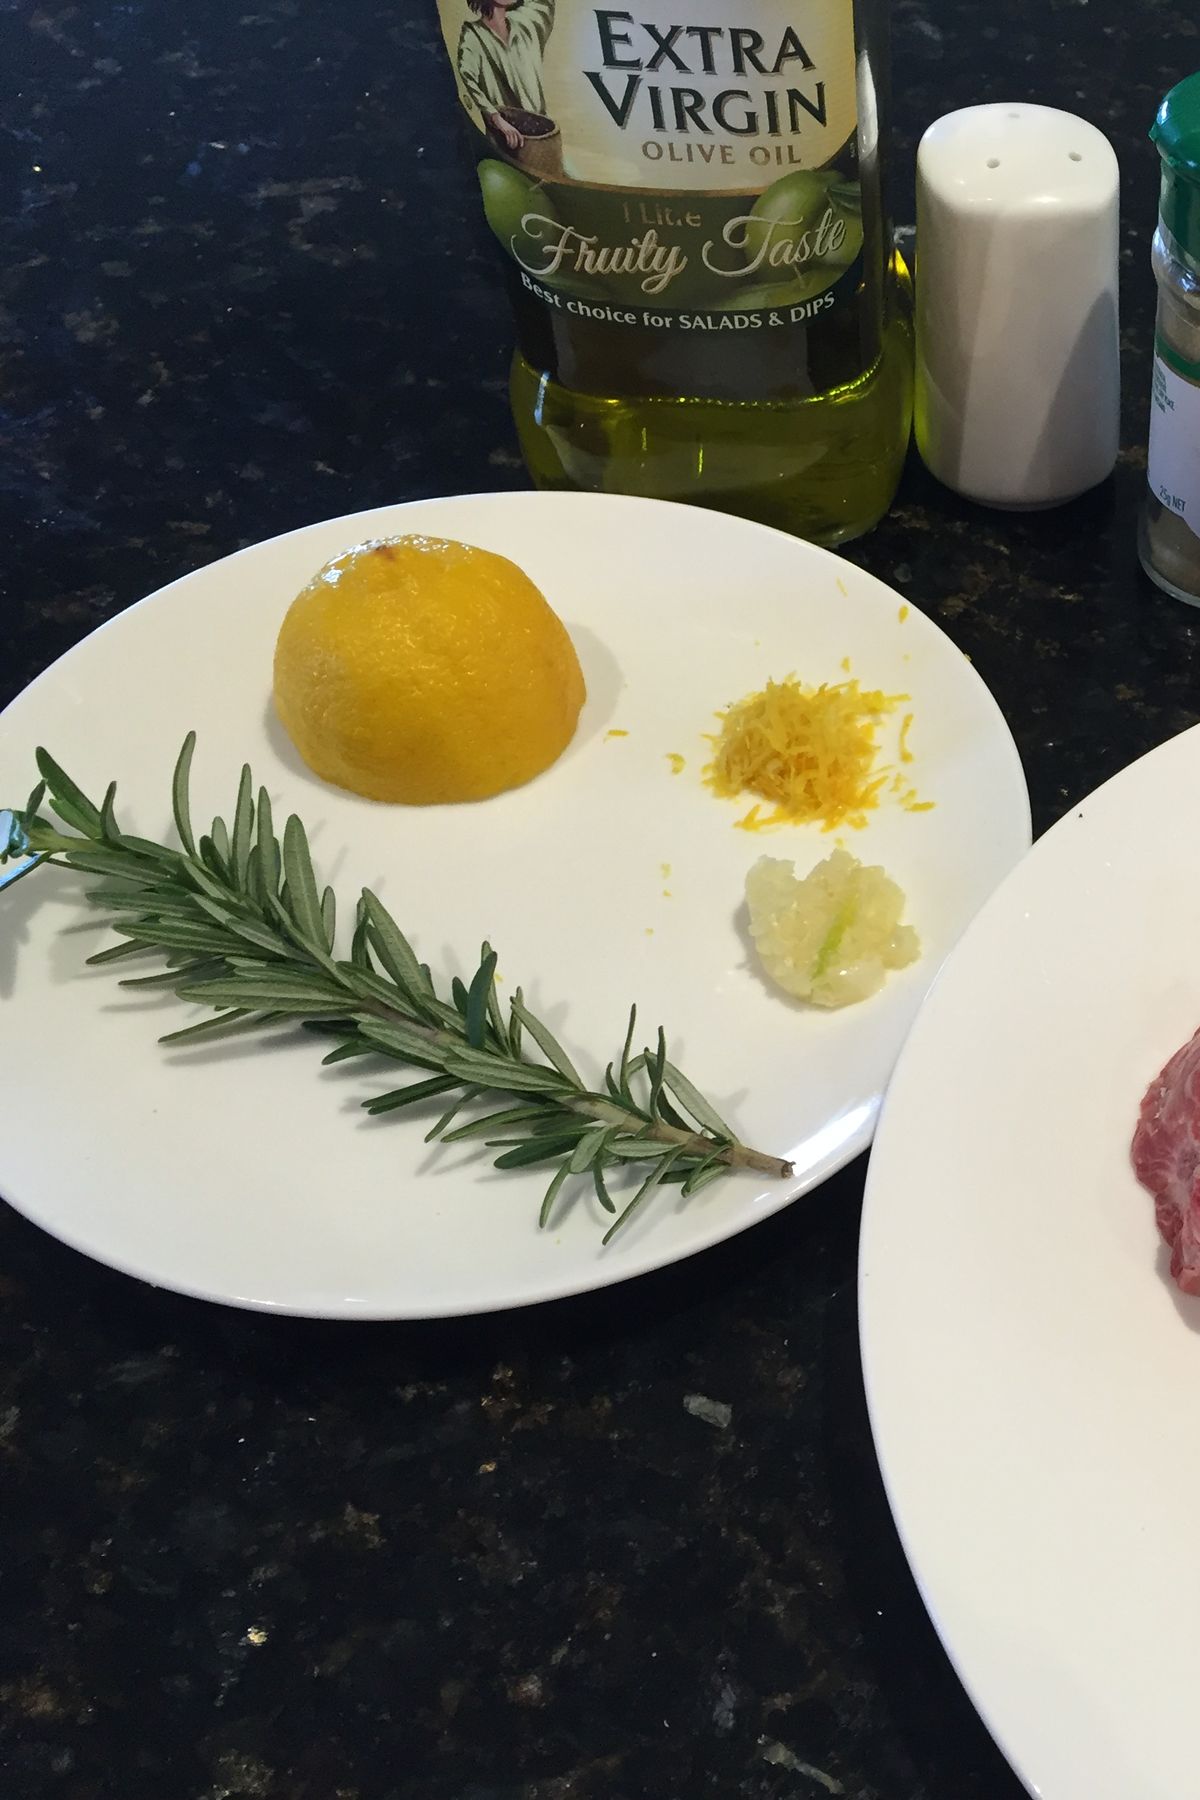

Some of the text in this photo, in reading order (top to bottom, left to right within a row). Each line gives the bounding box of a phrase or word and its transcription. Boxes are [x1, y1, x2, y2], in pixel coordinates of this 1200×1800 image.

[593, 9, 816, 76] EXTRA
[583, 71, 827, 138] VIRGIN
[641, 141, 802, 166] OLIVE OIL
[640, 203, 702, 227] Lite
[511, 208, 847, 293] Fruity Taste
[520, 272, 836, 330] Best choice for SALADS & DIPS
